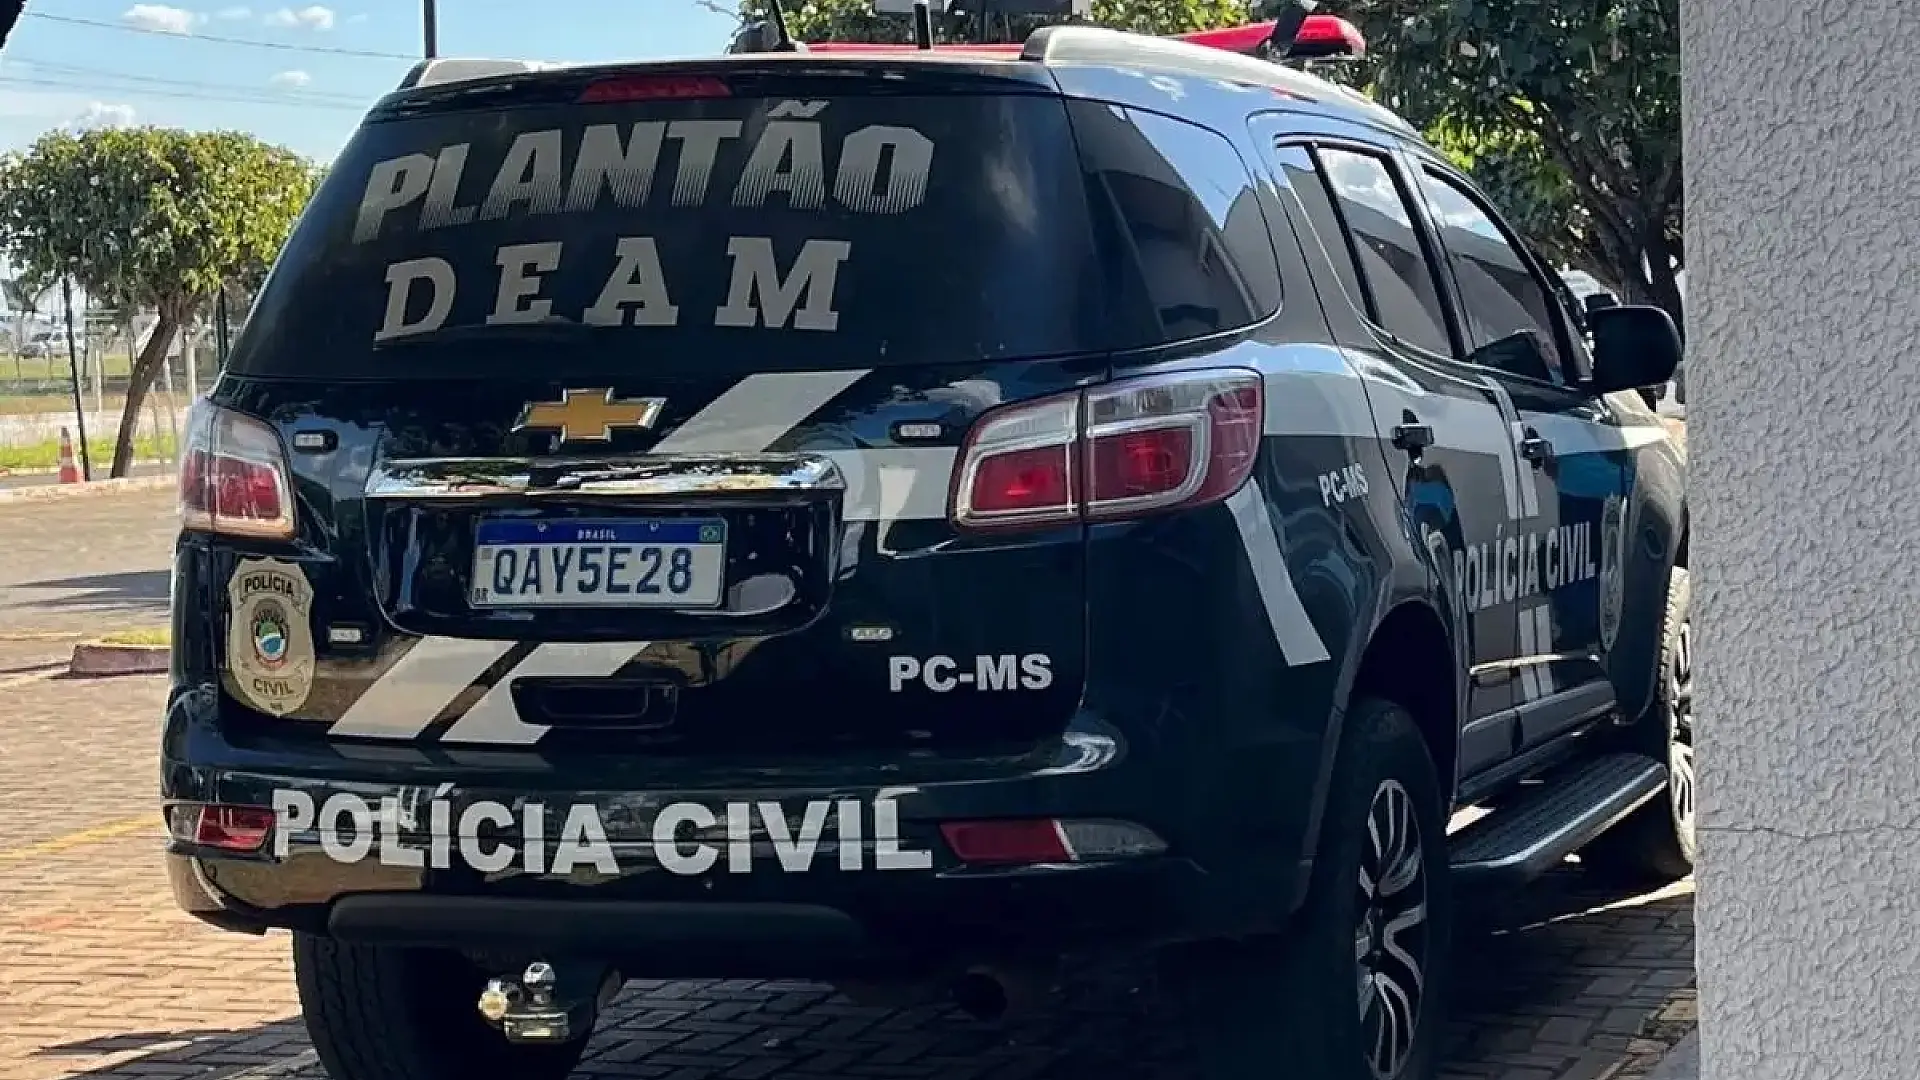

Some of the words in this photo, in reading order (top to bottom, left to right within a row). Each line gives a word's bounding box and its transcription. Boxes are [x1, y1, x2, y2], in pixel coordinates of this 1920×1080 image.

[352, 99, 935, 244] PLANTÃO
[374, 237, 852, 344] DEAM
[1317, 462, 1369, 508] PC-MS
[577, 528, 617, 541] BRASIL
[493, 546, 693, 595] QAY5E28
[1452, 523, 1541, 622] POLÍCIA
[1546, 521, 1596, 590] CIVIL
[253, 678, 294, 696] CIVIL
[888, 653, 1053, 693] PC-MS
[272, 782, 621, 875] POLÍCIA
[652, 796, 934, 875] CIVIL
